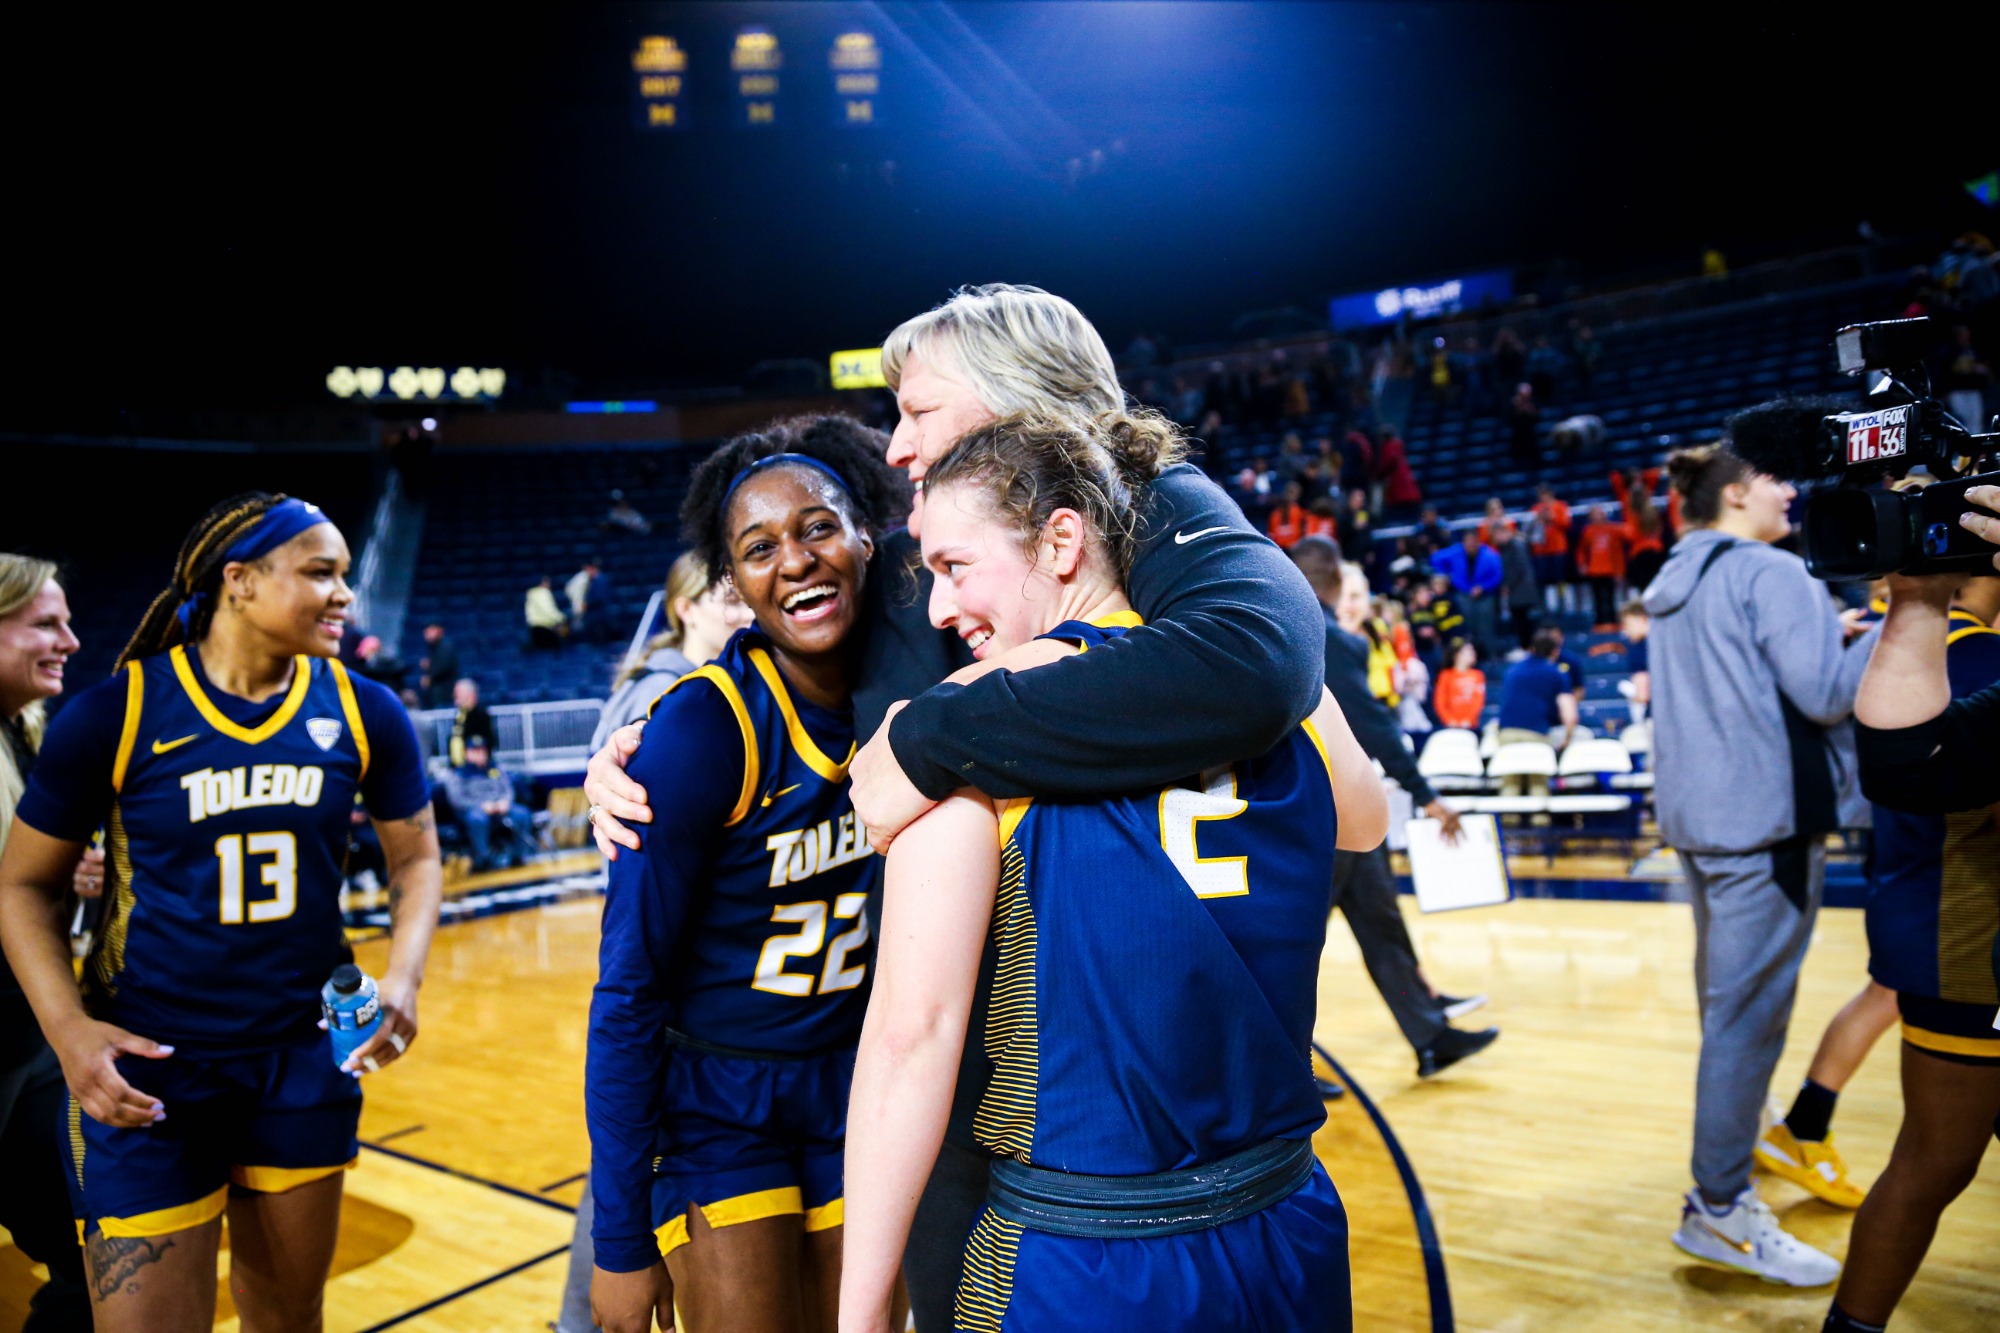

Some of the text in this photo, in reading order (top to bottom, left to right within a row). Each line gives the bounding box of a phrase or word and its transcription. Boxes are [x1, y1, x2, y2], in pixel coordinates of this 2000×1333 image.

[1853, 416, 1879, 429] WTOL
[1880, 427, 1900, 456] 36
[1884, 408, 1906, 427] FOX
[180, 764, 324, 823] TOLEDO
[766, 811, 875, 888] TOLED
[1158, 762, 1250, 899] 2
[215, 830, 297, 925] 13
[752, 892, 870, 997] 22
